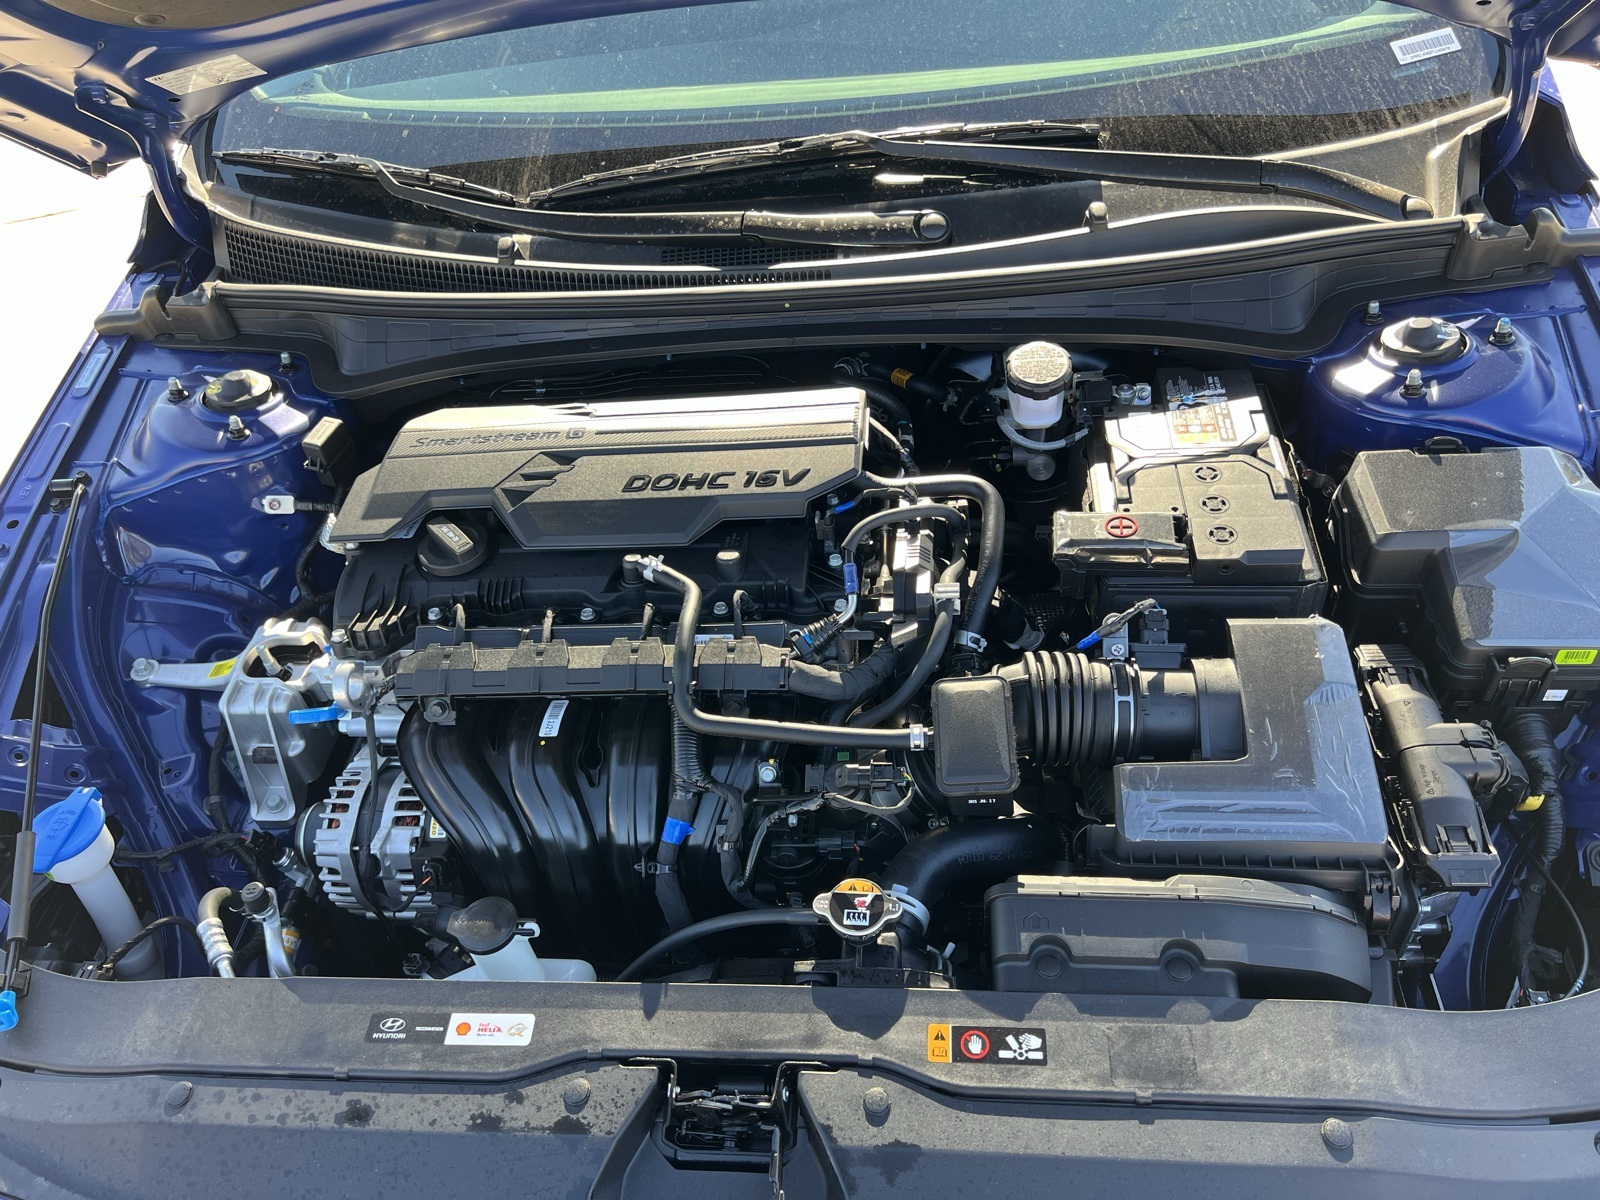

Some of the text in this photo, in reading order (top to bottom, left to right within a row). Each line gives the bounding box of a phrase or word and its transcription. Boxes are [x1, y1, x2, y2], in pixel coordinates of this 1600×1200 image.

[410, 430, 560, 449] Smartstream
[621, 467, 811, 493] DOHC 16V
